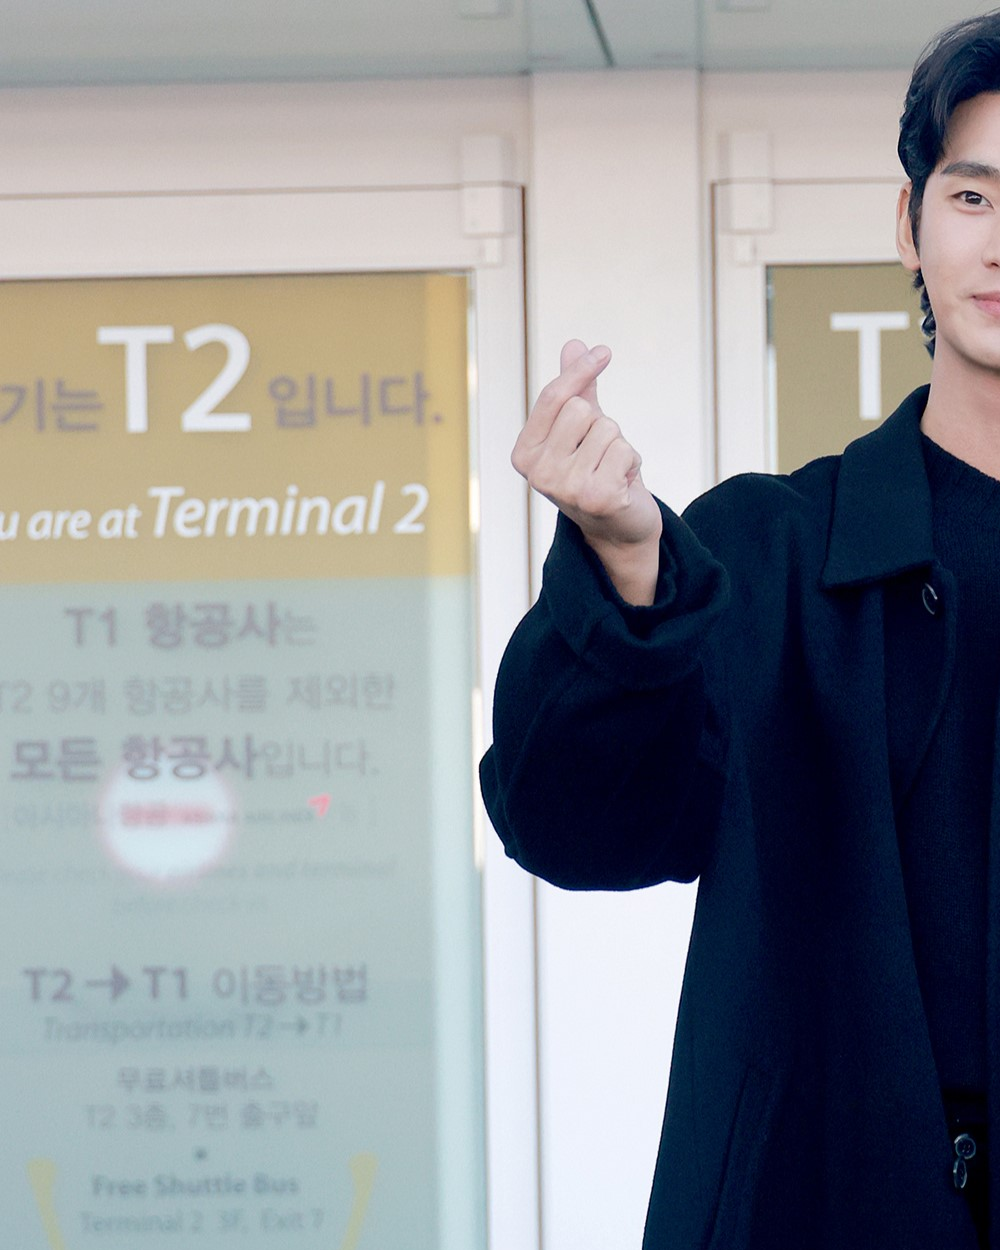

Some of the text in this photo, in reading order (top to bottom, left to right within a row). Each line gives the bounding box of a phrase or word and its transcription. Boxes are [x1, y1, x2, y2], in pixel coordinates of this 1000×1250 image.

[97, 323, 252, 433] T2
[269, 372, 443, 428] 입니다.
[27, 509, 92, 541] are
[98, 503, 142, 540] at
[148, 480, 385, 538] Terminal
[393, 483, 429, 535] 2
[64, 602, 319, 650] T1 항공사는
[47, 678, 107, 716] 9개
[125, 674, 269, 717] 항공사를
[286, 671, 396, 712] 제외한
[11, 733, 381, 782] 모든 항공사입니다.
[23, 962, 370, 1006] T2 T1 이동방법
